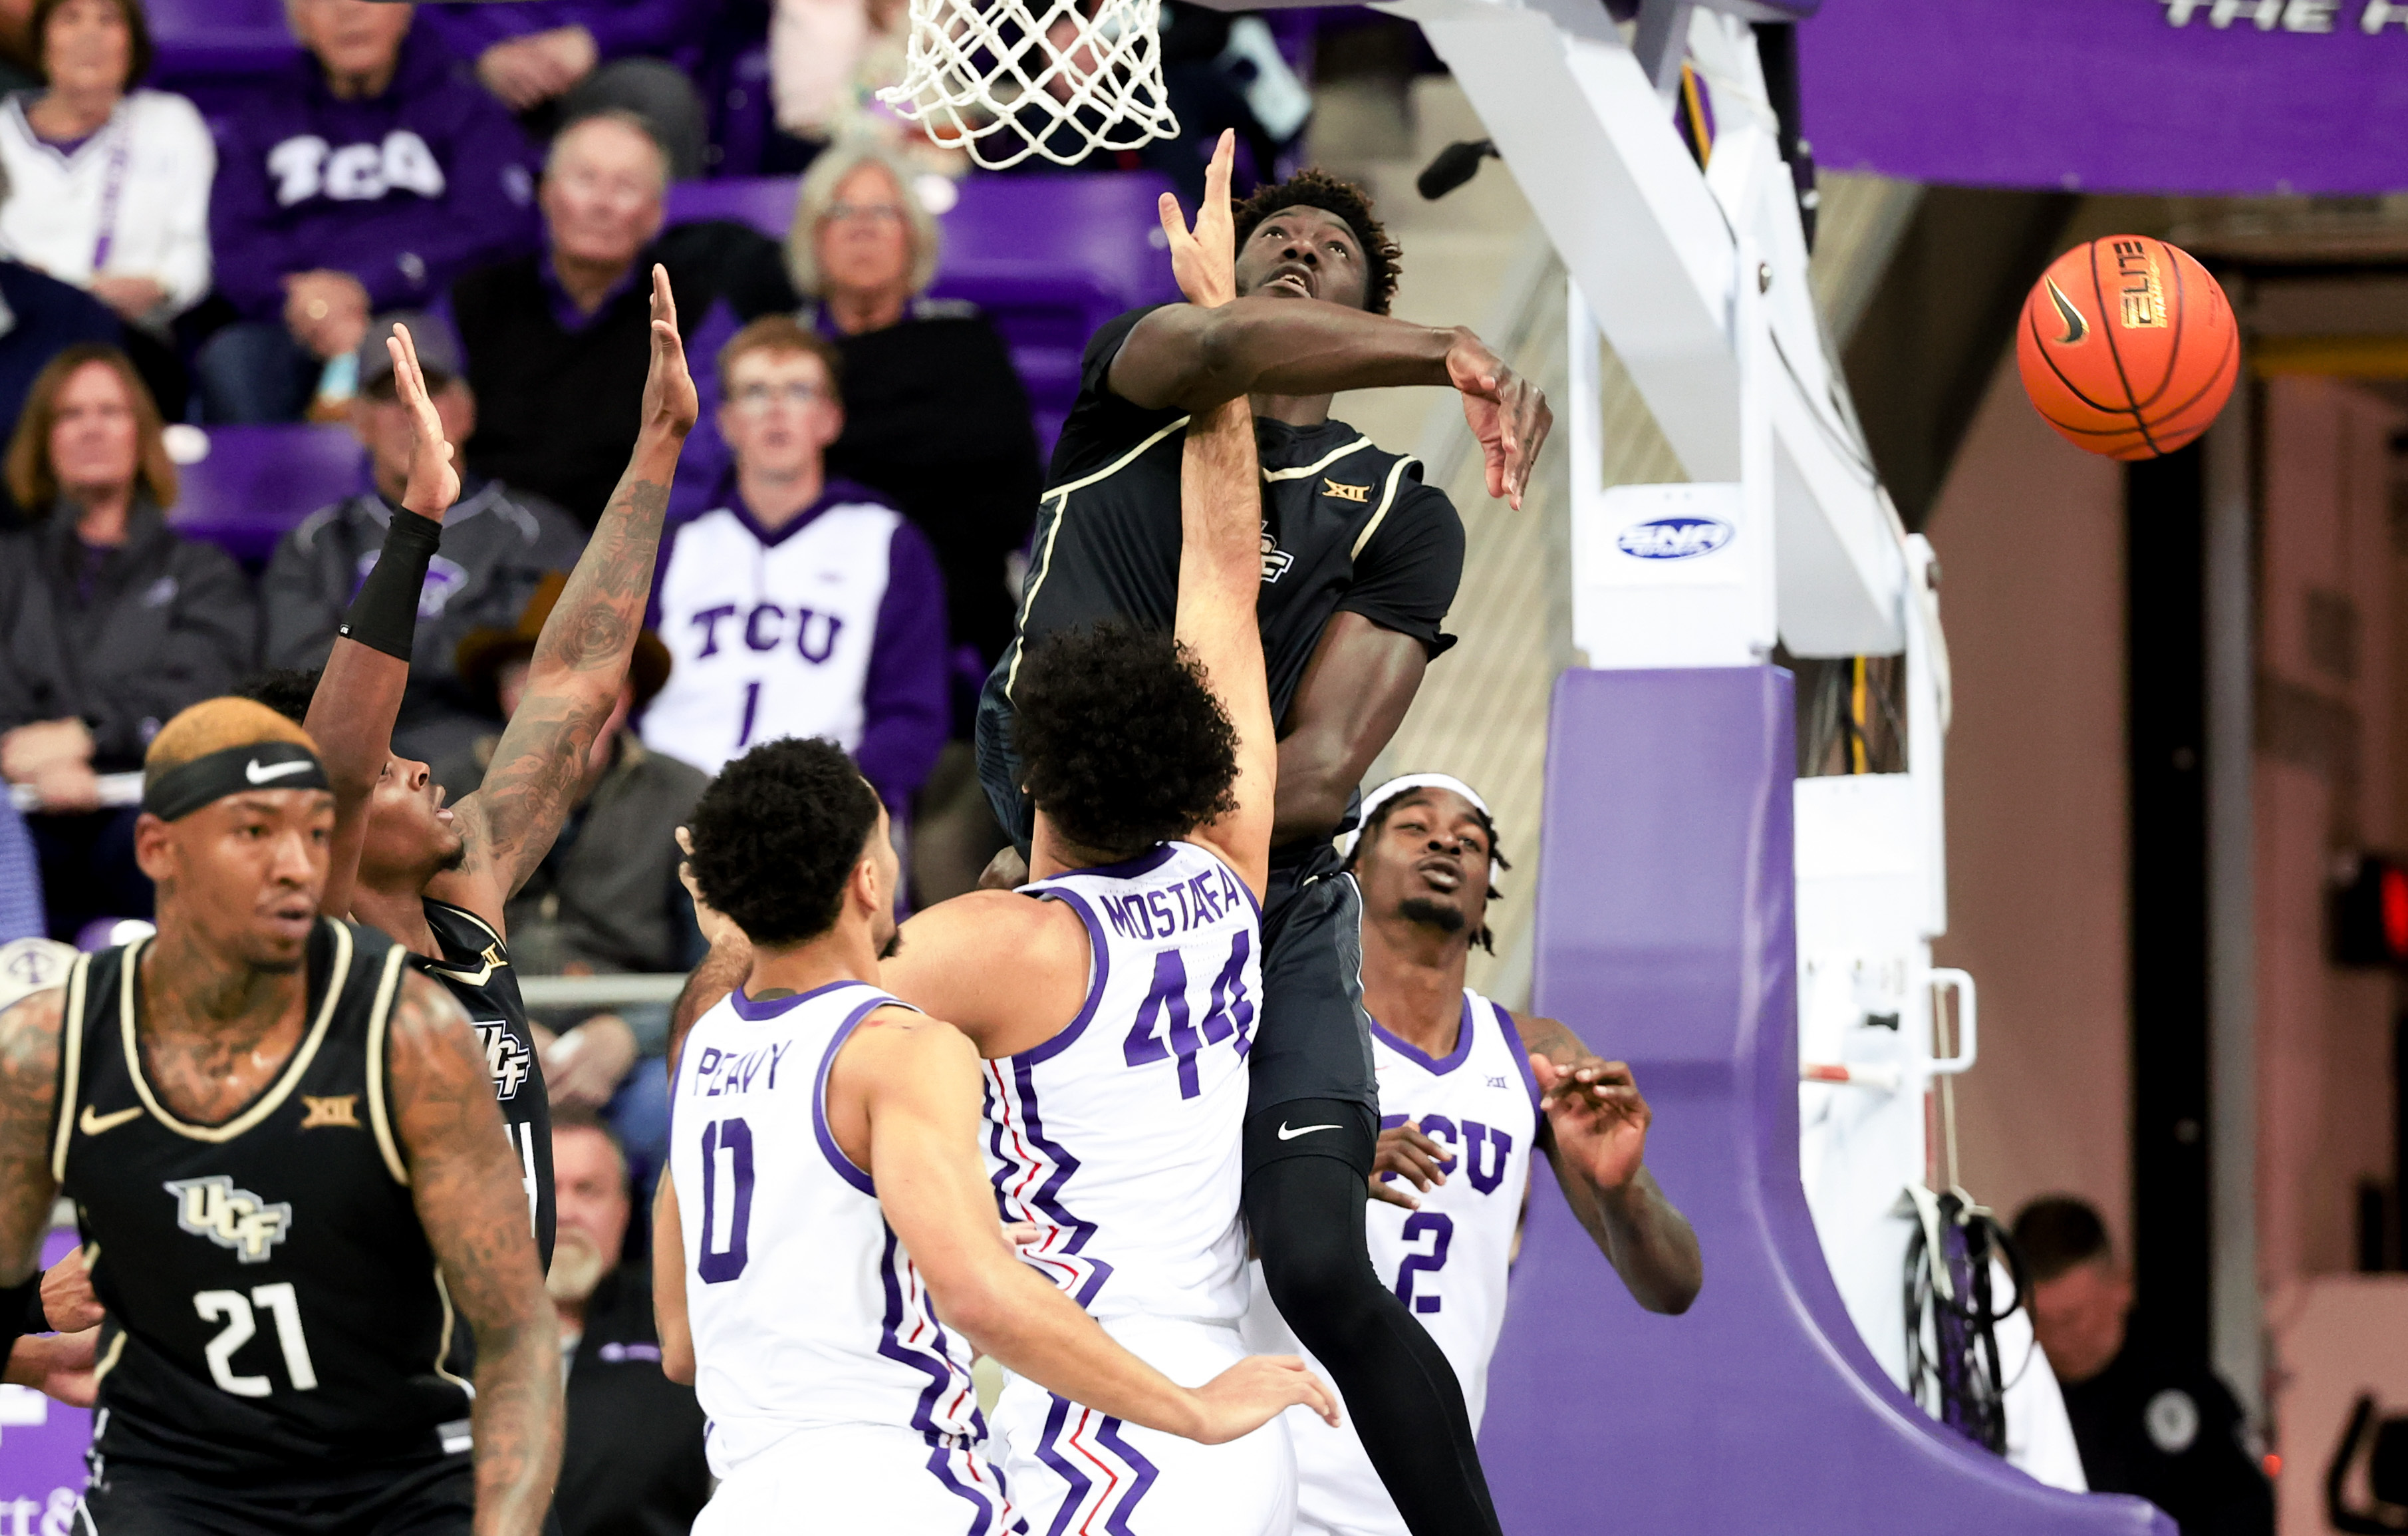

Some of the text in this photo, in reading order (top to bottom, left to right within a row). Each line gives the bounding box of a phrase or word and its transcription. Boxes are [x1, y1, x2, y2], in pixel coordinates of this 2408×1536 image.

[2113, 241, 2153, 325] ELITE
[1321, 477, 1371, 503] XII
[692, 603, 843, 664] TCU
[1099, 863, 1240, 939] MOSTAFA
[1123, 929, 1254, 1100] 44
[693, 1040, 793, 1096] PEAVY
[300, 1094, 362, 1129] XII
[162, 1175, 293, 1263] UCF
[1395, 1212, 1454, 1313] 2
[193, 1282, 319, 1398] 21
